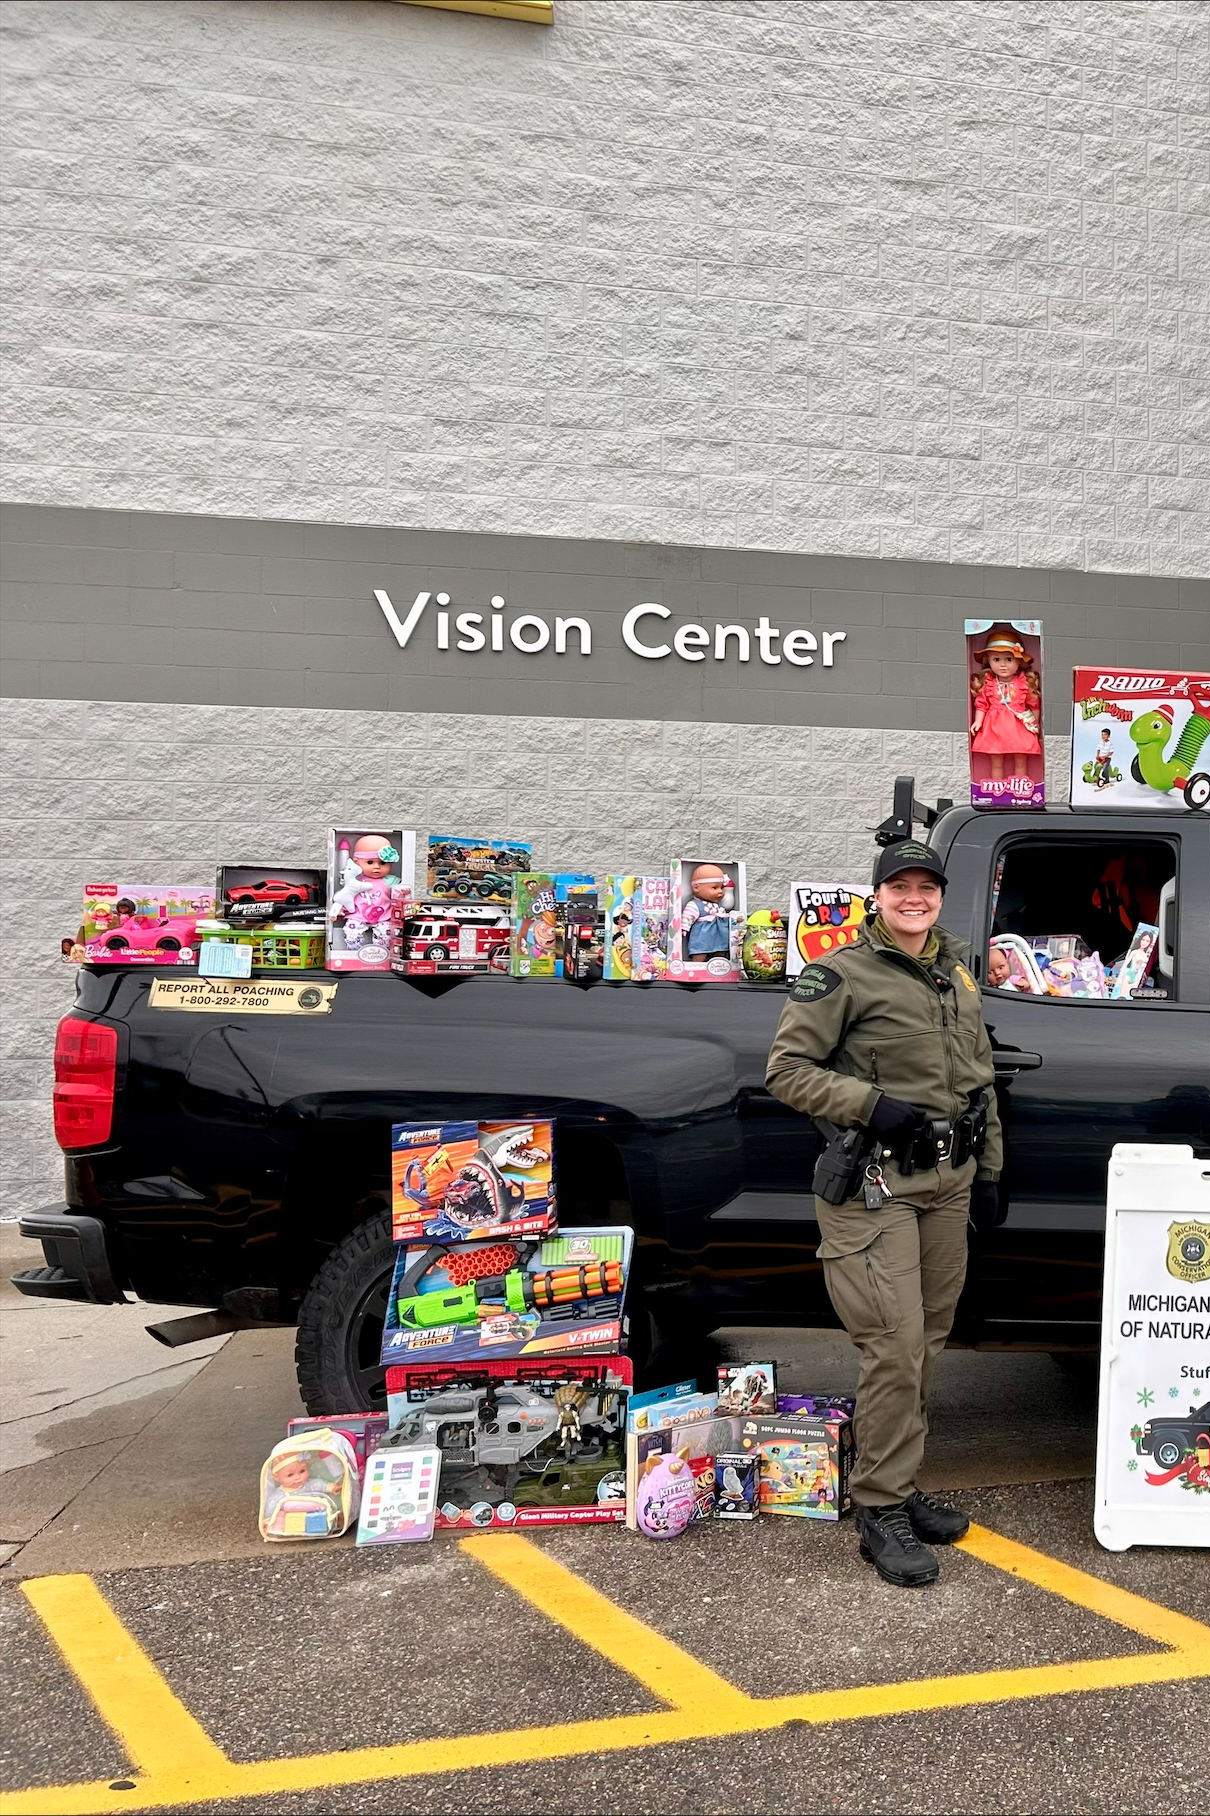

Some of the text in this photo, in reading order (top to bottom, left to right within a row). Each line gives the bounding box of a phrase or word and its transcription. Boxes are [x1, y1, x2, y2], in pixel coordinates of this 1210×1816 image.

[373, 589, 847, 667] Vision Center
[1091, 675, 1166, 693] RADIO
[1080, 698, 1133, 722] Inchworm
[465, 863, 496, 871] TRUCKS
[798, 888, 851, 908] Four in
[806, 910, 818, 925] a
[85, 945, 113, 958] Barbie
[158, 984, 294, 997] REPORT ALL POACHING
[179, 995, 269, 1007] 1-800-292-7800
[398, 1127, 442, 1142] ADVENTURE
[523, 1220, 543, 1229] BITE
[569, 1239, 588, 1250] 30
[1128, 1294, 1210, 1313] MICHIGAN
[1120, 1321, 1143, 1337] OF
[390, 1326, 456, 1347] ADVENTURE
[412, 1336, 450, 1349] FORCE
[568, 1328, 614, 1344] V-TWIN
[675, 1383, 692, 1393] Glitter
[792, 1428, 807, 1436] FLOOR
[647, 1436, 662, 1449] WISH
[501, 1508, 512, 1516] 57
[520, 1513, 545, 1521] Giant
[546, 1512, 568, 1521] Military
[569, 1511, 594, 1520] Copter
[595, 1511, 610, 1519] Play
